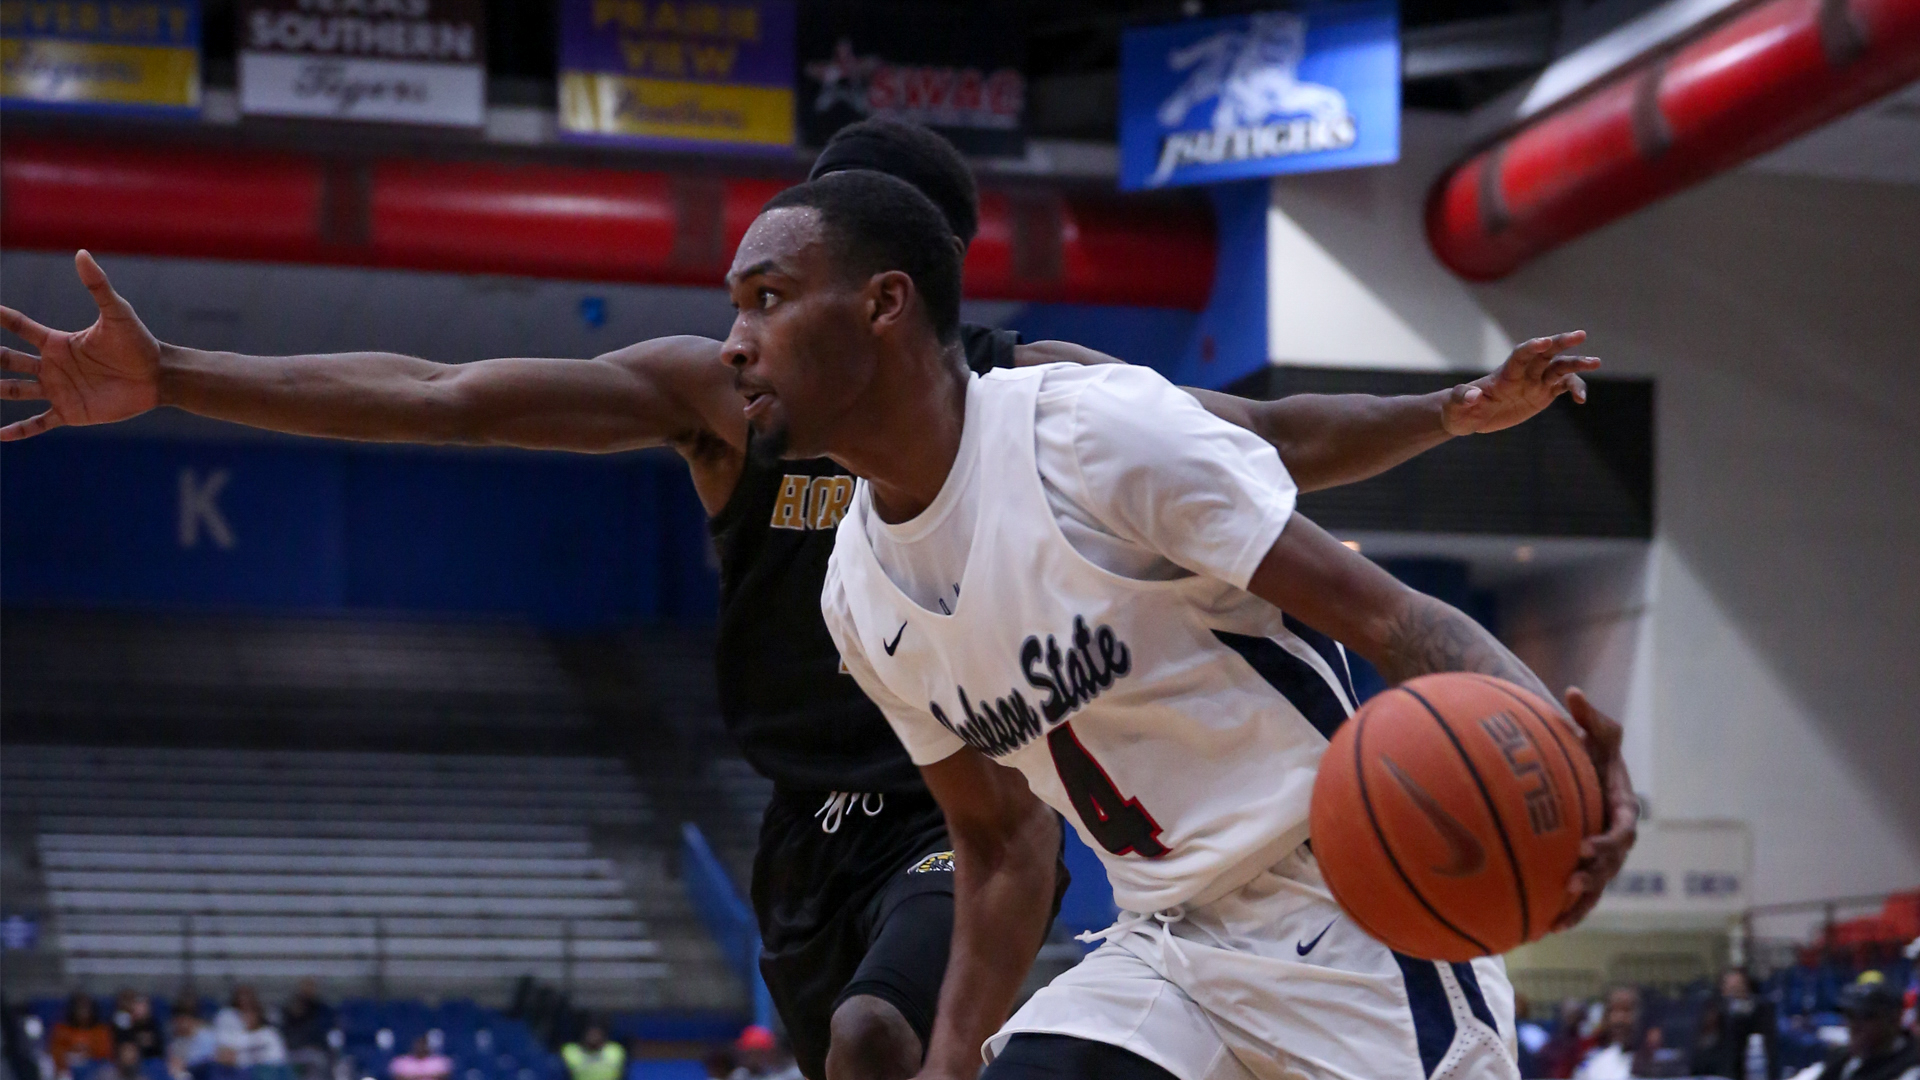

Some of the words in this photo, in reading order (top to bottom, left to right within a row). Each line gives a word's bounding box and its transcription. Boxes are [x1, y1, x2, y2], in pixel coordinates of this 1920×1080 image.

[251, 9, 476, 58] SOUTHERN
[621, 39, 741, 78] VIEW
[868, 64, 1026, 120] SWAC
[179, 467, 234, 548] K
[1019, 614, 1132, 725] State
[1047, 720, 1174, 860] 4
